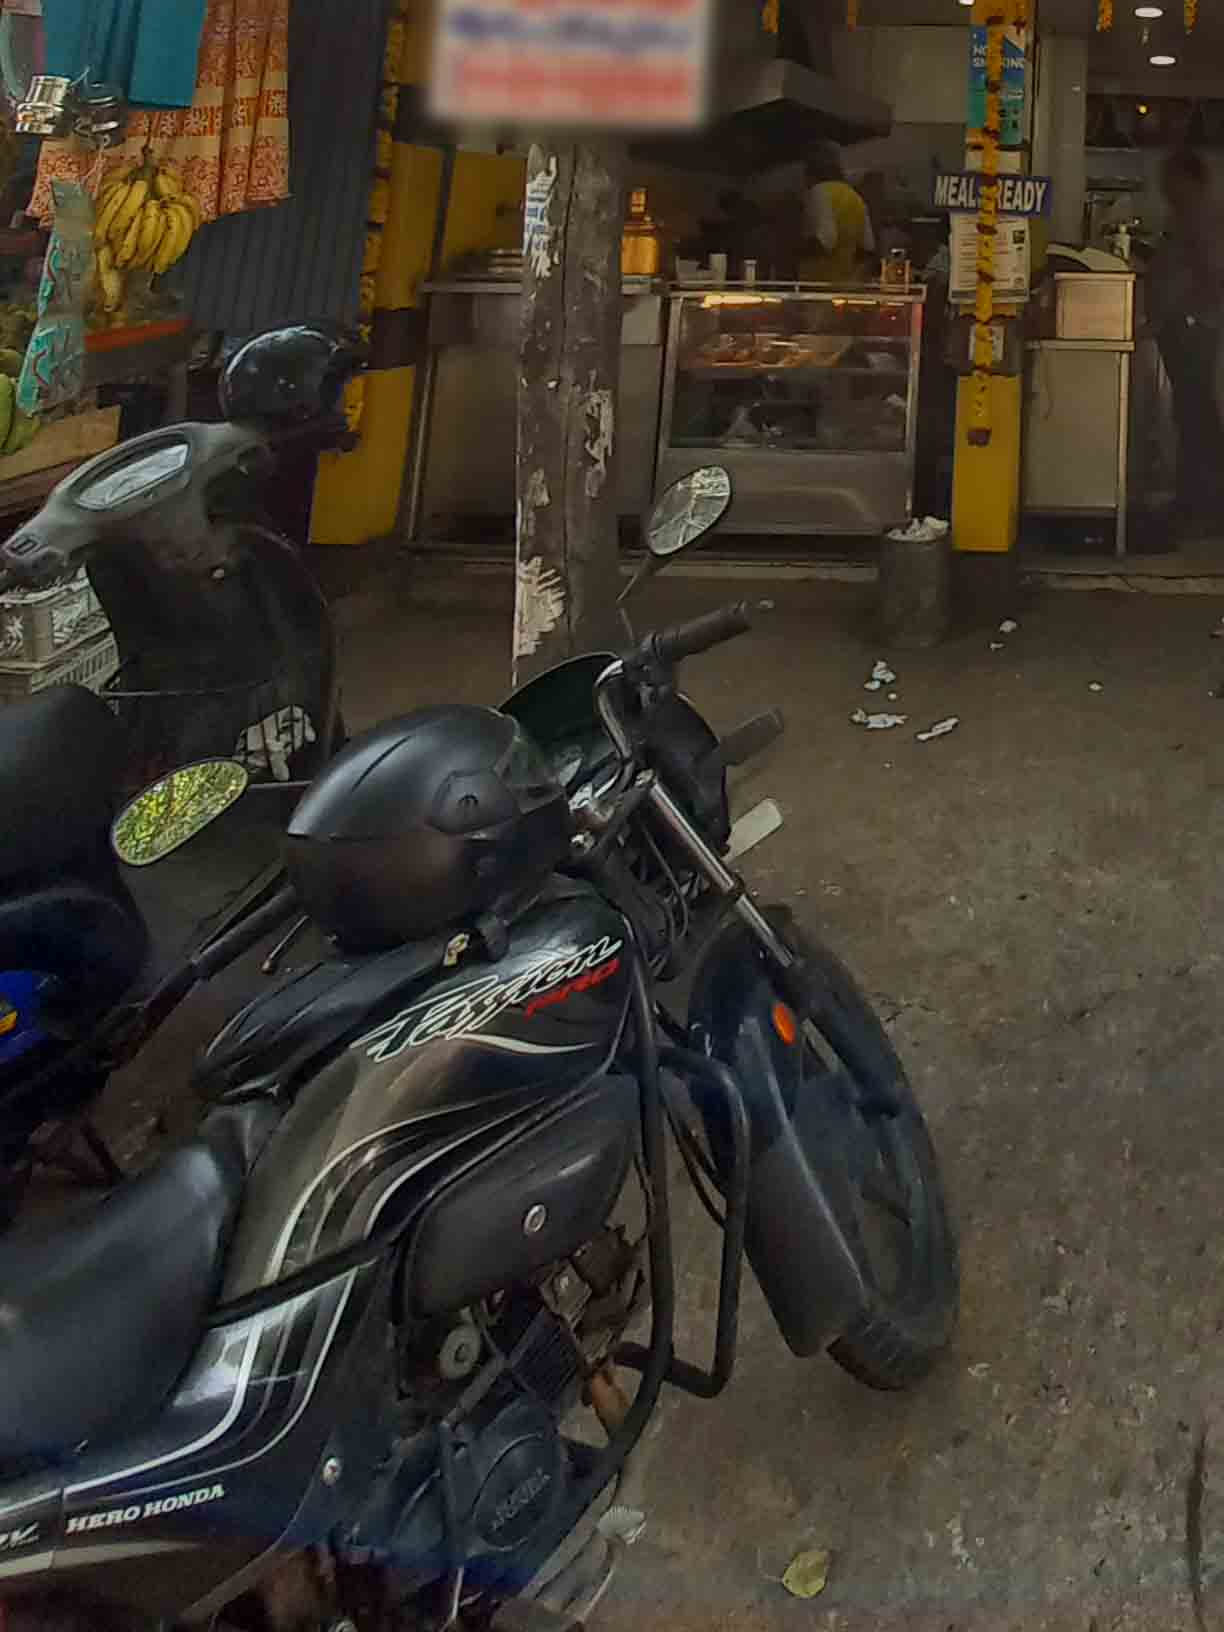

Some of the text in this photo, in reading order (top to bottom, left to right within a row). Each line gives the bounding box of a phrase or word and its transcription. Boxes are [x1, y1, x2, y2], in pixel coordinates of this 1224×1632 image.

[934, 175, 983, 209] MEAL
[65, 1483, 225, 1535] HERO HONDA
